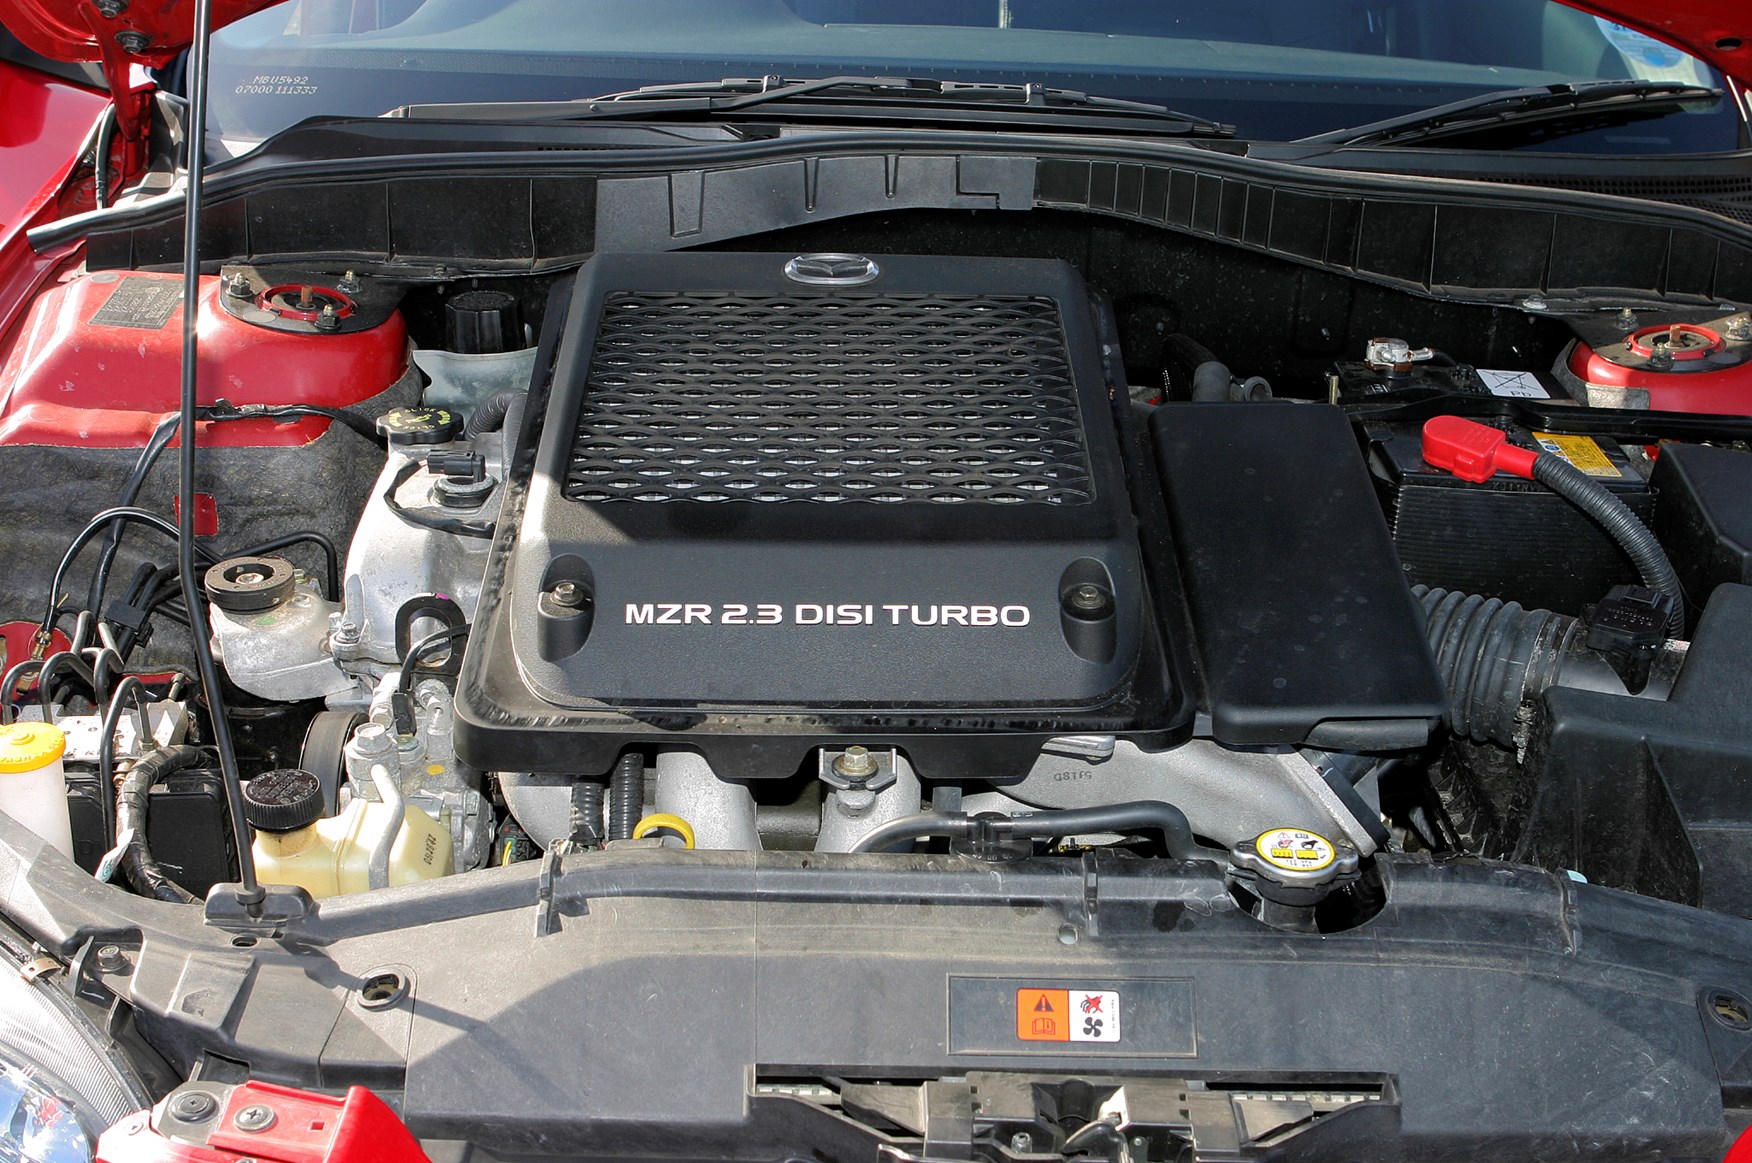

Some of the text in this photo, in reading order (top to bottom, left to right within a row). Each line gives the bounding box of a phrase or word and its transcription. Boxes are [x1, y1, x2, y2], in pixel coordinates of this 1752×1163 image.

[234, 85, 319, 95] 07000 111333
[625, 603, 1031, 627] MZR 2.3 DISI TURBO
